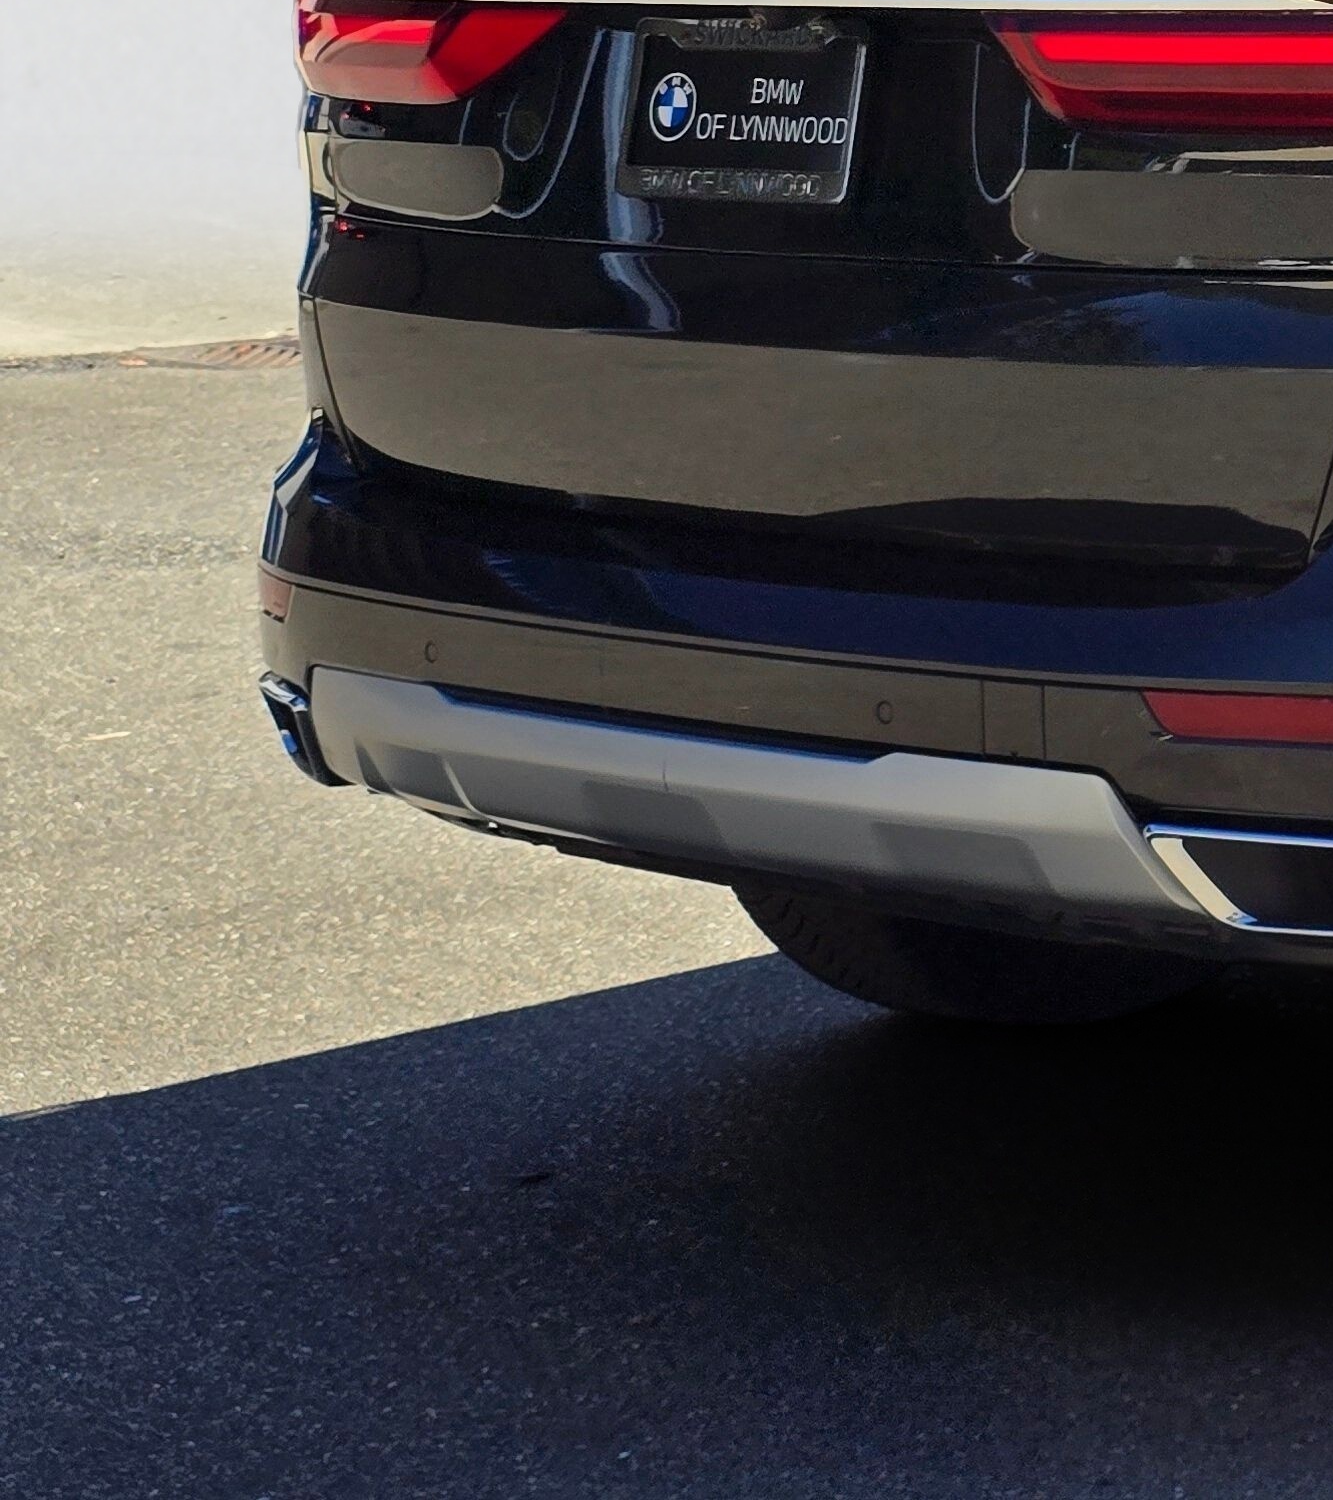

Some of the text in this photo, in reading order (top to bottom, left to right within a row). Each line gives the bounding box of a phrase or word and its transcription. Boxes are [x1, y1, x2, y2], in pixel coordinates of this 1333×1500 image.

[750, 78, 804, 104] BMW
[696, 113, 848, 144] OF LYNNWOOD
